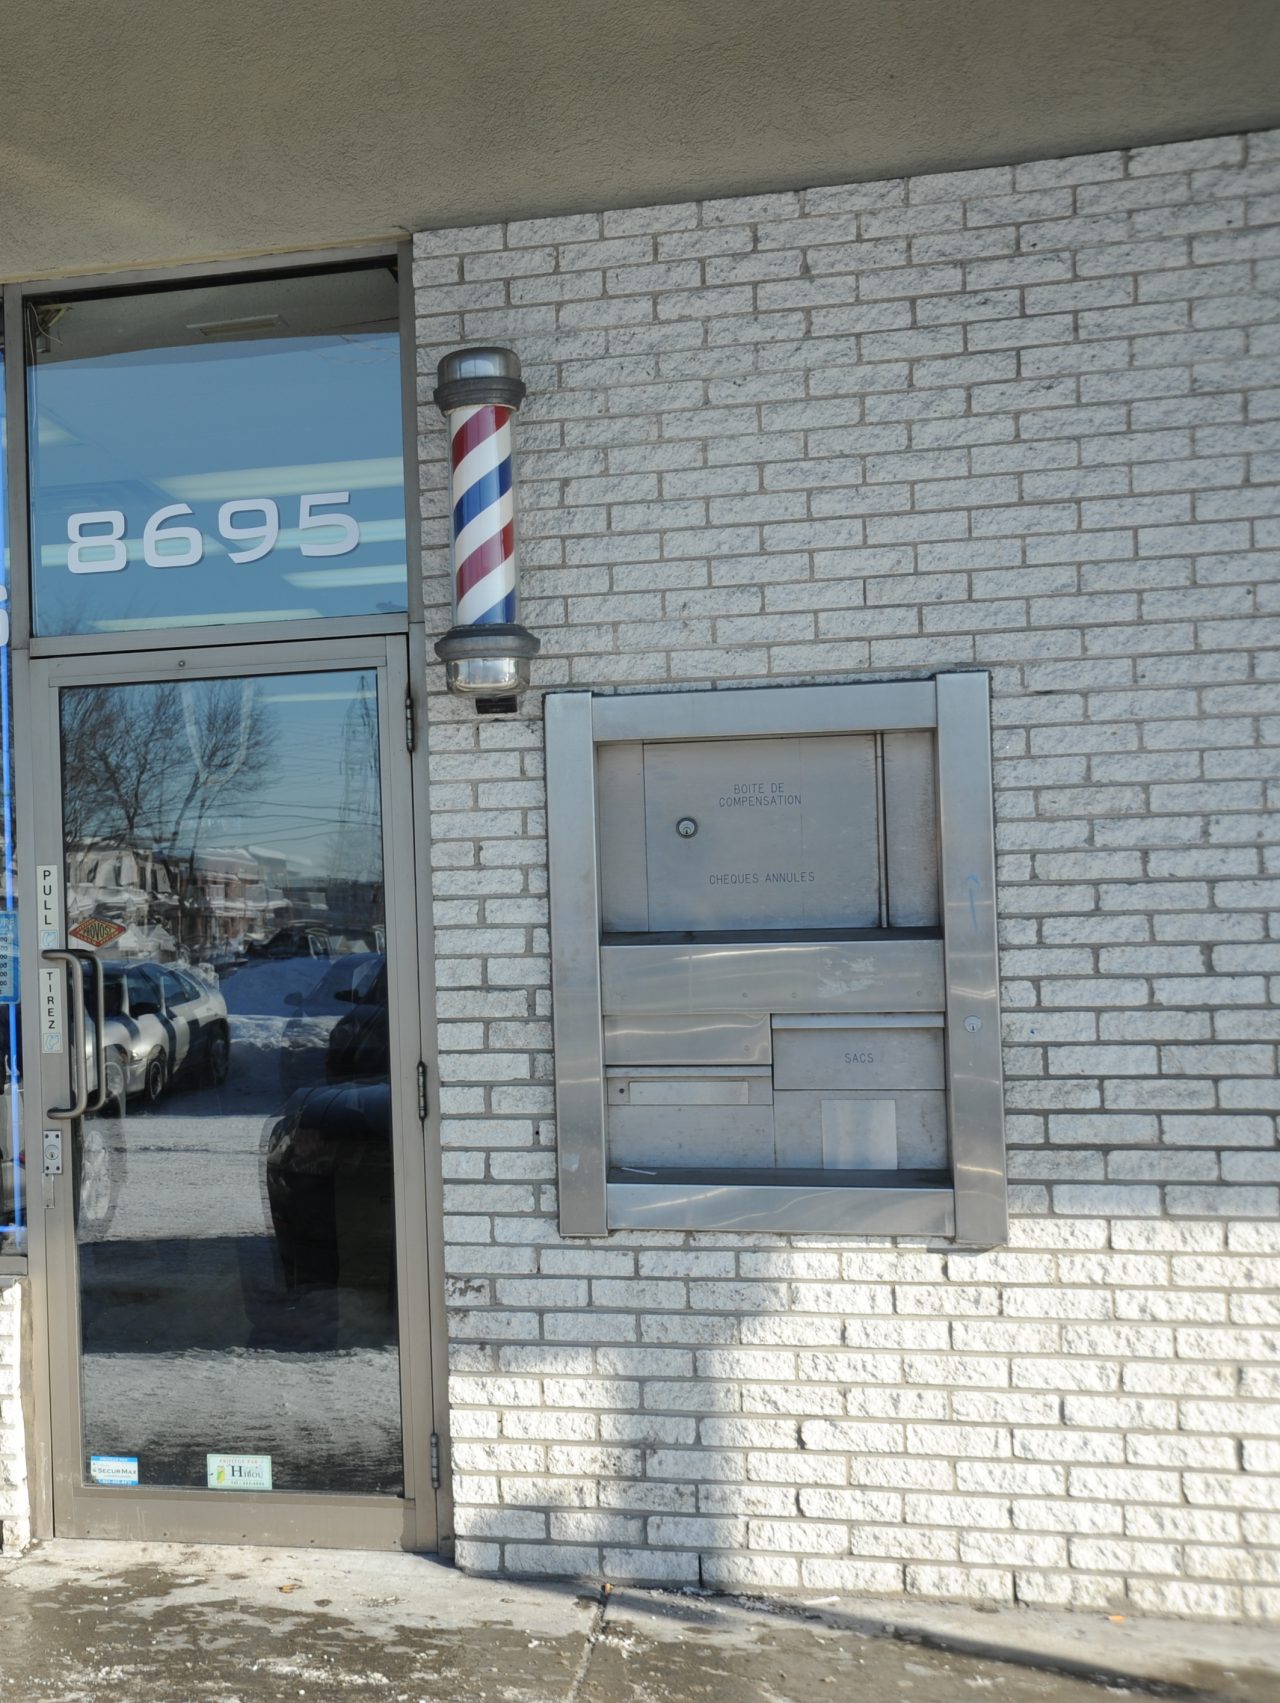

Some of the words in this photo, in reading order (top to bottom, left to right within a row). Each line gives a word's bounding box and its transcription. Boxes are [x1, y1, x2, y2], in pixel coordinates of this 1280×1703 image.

[67, 491, 360, 574] 8695
[733, 783, 765, 795] BOITE
[770, 782, 785, 793] DE
[719, 795, 802, 807] COMPENSATION
[709, 873, 759, 885] CHEQUES
[765, 872, 815, 883] ANNULES
[43, 870, 52, 925] PULL
[46, 972, 55, 1029] TIREZ
[844, 1052, 874, 1064] SACS
